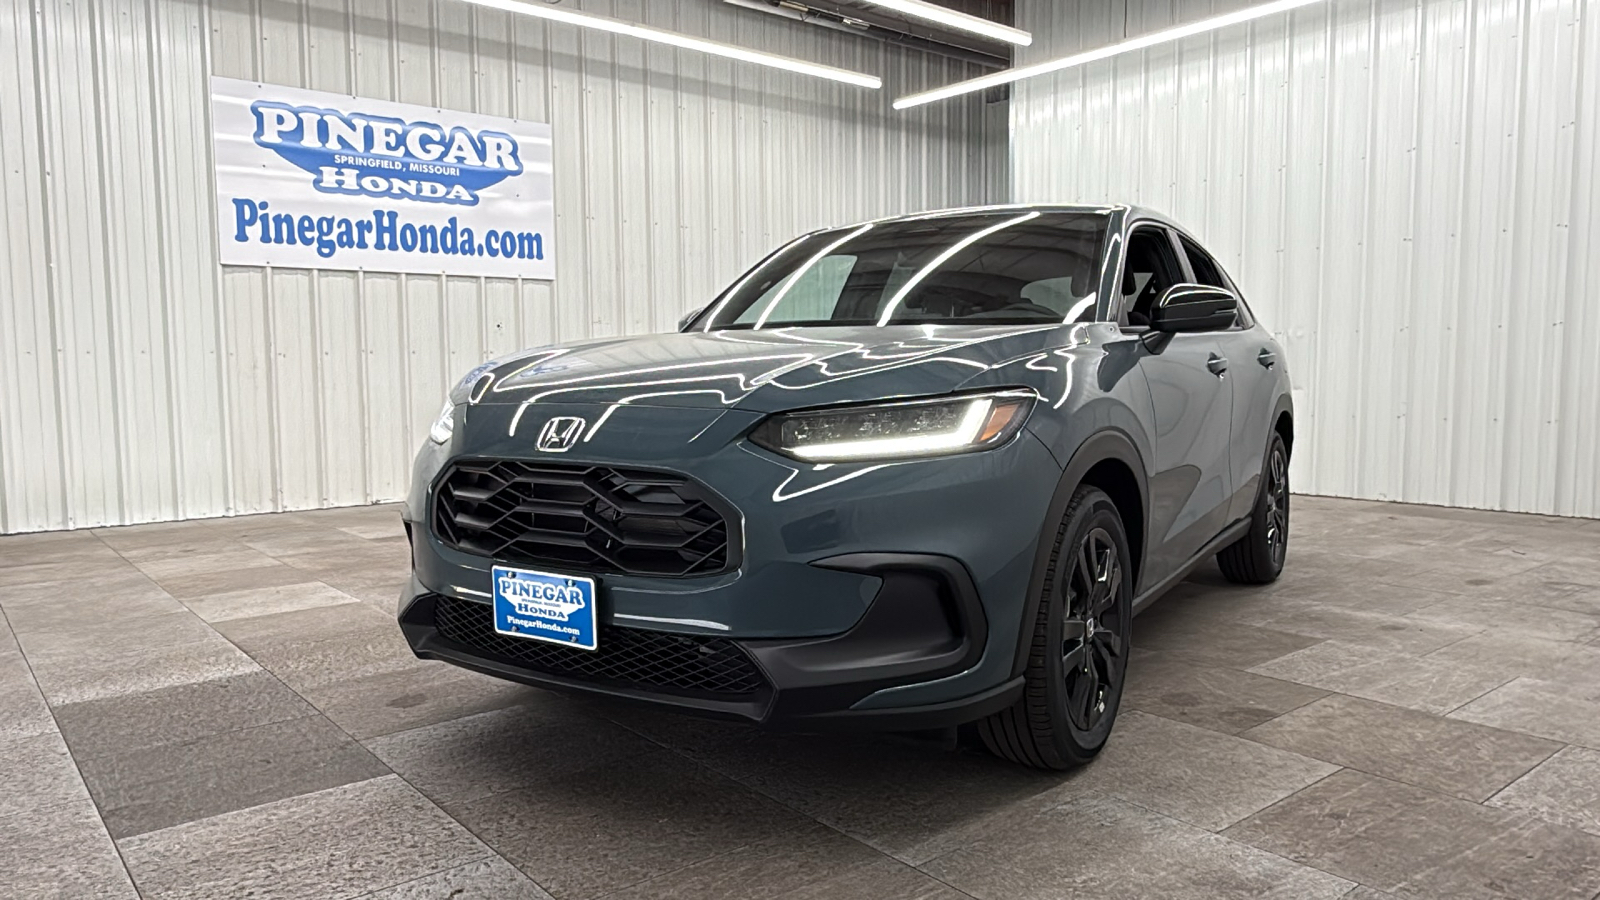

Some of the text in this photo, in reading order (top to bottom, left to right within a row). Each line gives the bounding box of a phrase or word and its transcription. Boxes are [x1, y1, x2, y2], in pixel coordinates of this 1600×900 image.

[257, 106, 518, 171] PINEGAR
[334, 154, 460, 177] SPRINGFIELD, MISSOURI
[318, 166, 475, 201] HONDA
[232, 197, 544, 260] PinegarHonda.com
[501, 580, 582, 605] PINEGAR
[517, 603, 566, 619] HONDA
[507, 615, 580, 635] PinegarHonda.com
